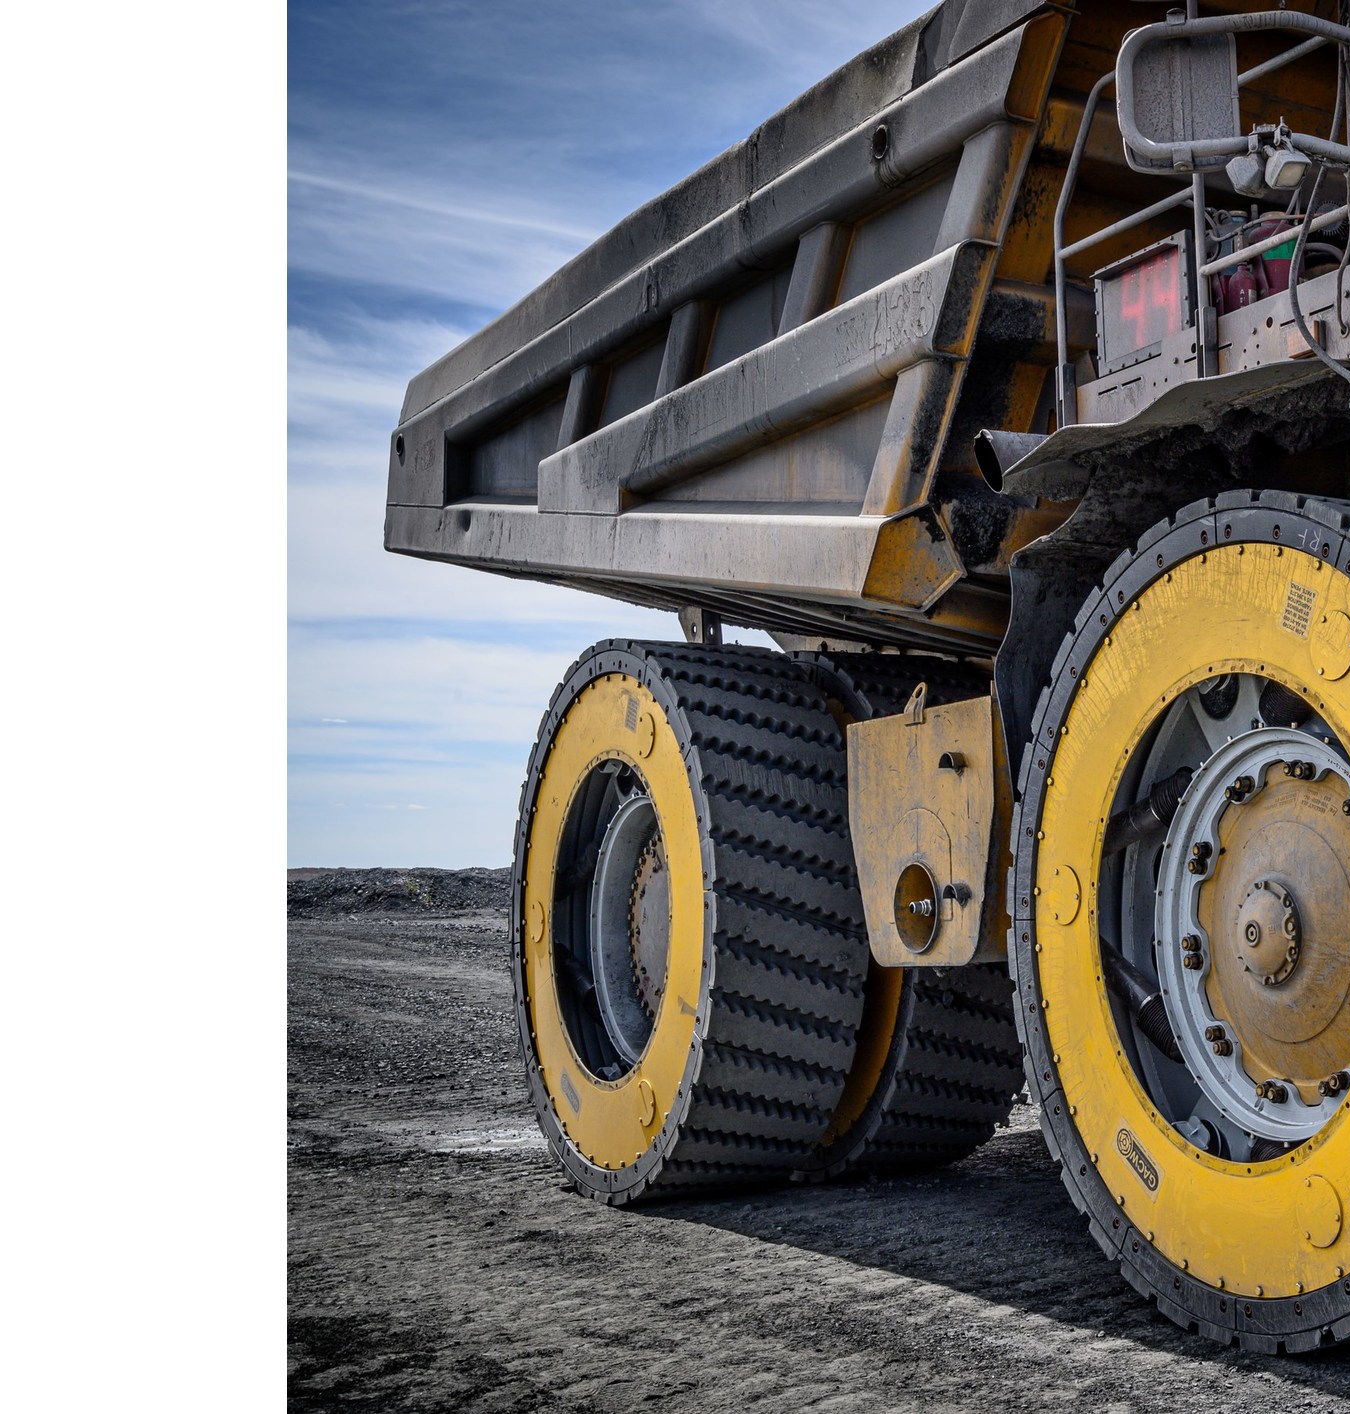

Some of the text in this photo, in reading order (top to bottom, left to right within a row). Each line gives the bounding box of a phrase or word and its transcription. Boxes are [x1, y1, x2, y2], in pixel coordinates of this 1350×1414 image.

[1120, 248, 1180, 348] 44
[1288, 596, 1311, 610] FABRICATION
[1298, 615, 1308, 623] MADE
[1129, 1150, 1156, 1188] GACW
